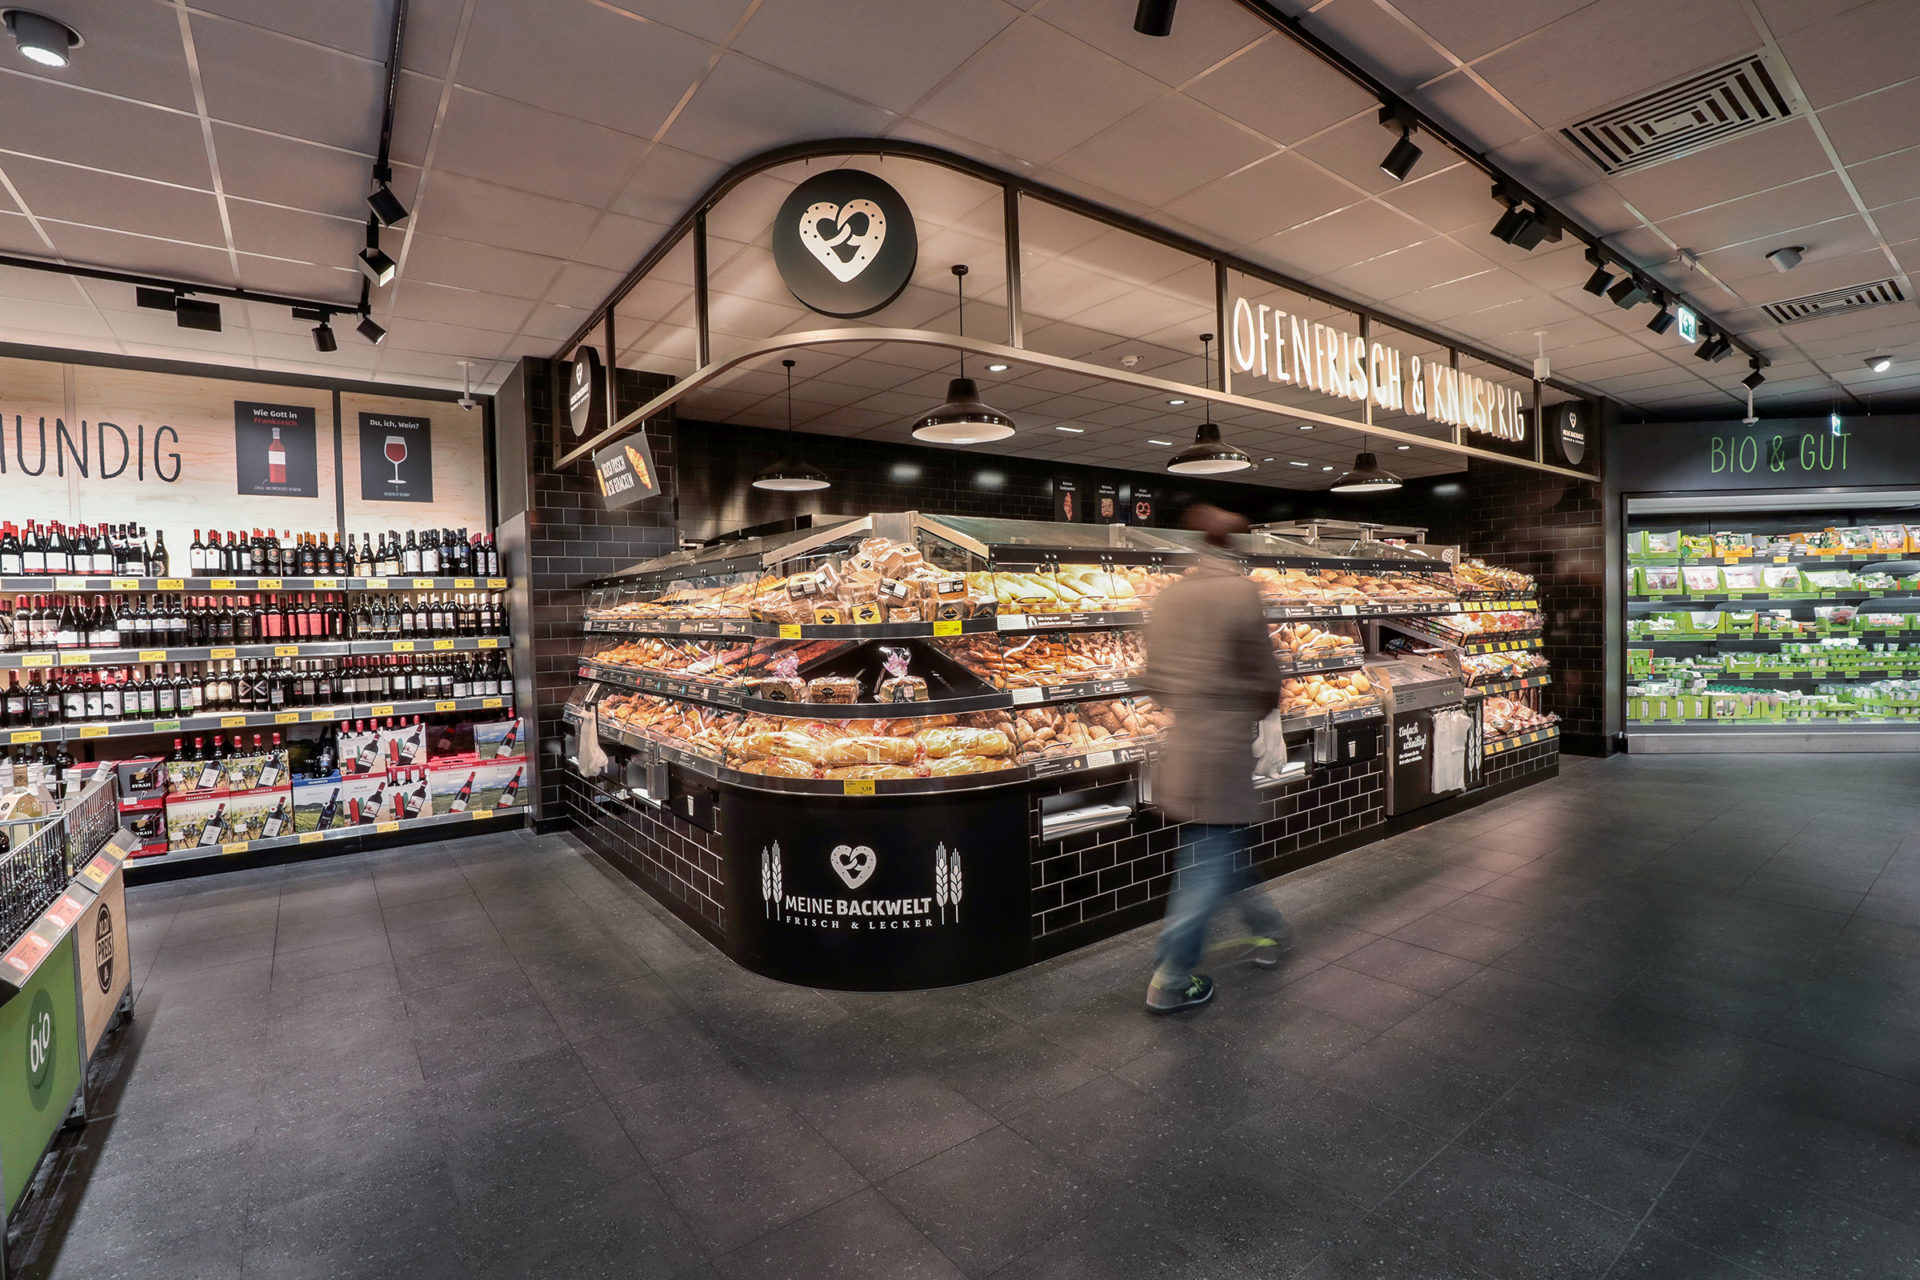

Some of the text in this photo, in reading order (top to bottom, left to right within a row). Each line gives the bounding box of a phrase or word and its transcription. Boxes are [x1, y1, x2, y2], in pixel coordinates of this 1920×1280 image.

[1233, 297, 1525, 442] OFENFRISCH & KNUSPRIG
[253, 409, 298, 419] Wie Gott in
[253, 417, 299, 426] Frankreich
[370, 419, 383, 427] Du,
[383, 420, 397, 428] ich,
[0, 413, 182, 483] UNDIG
[1711, 433, 1851, 473] BIO & GUT
[1399, 722, 1418, 740] Einfach
[785, 895, 932, 916] MEINE BACKWELT
[786, 916, 933, 930] FRISCH & LECKER
[97, 935, 112, 963] PREIS
[31, 1012, 51, 1073] bio
